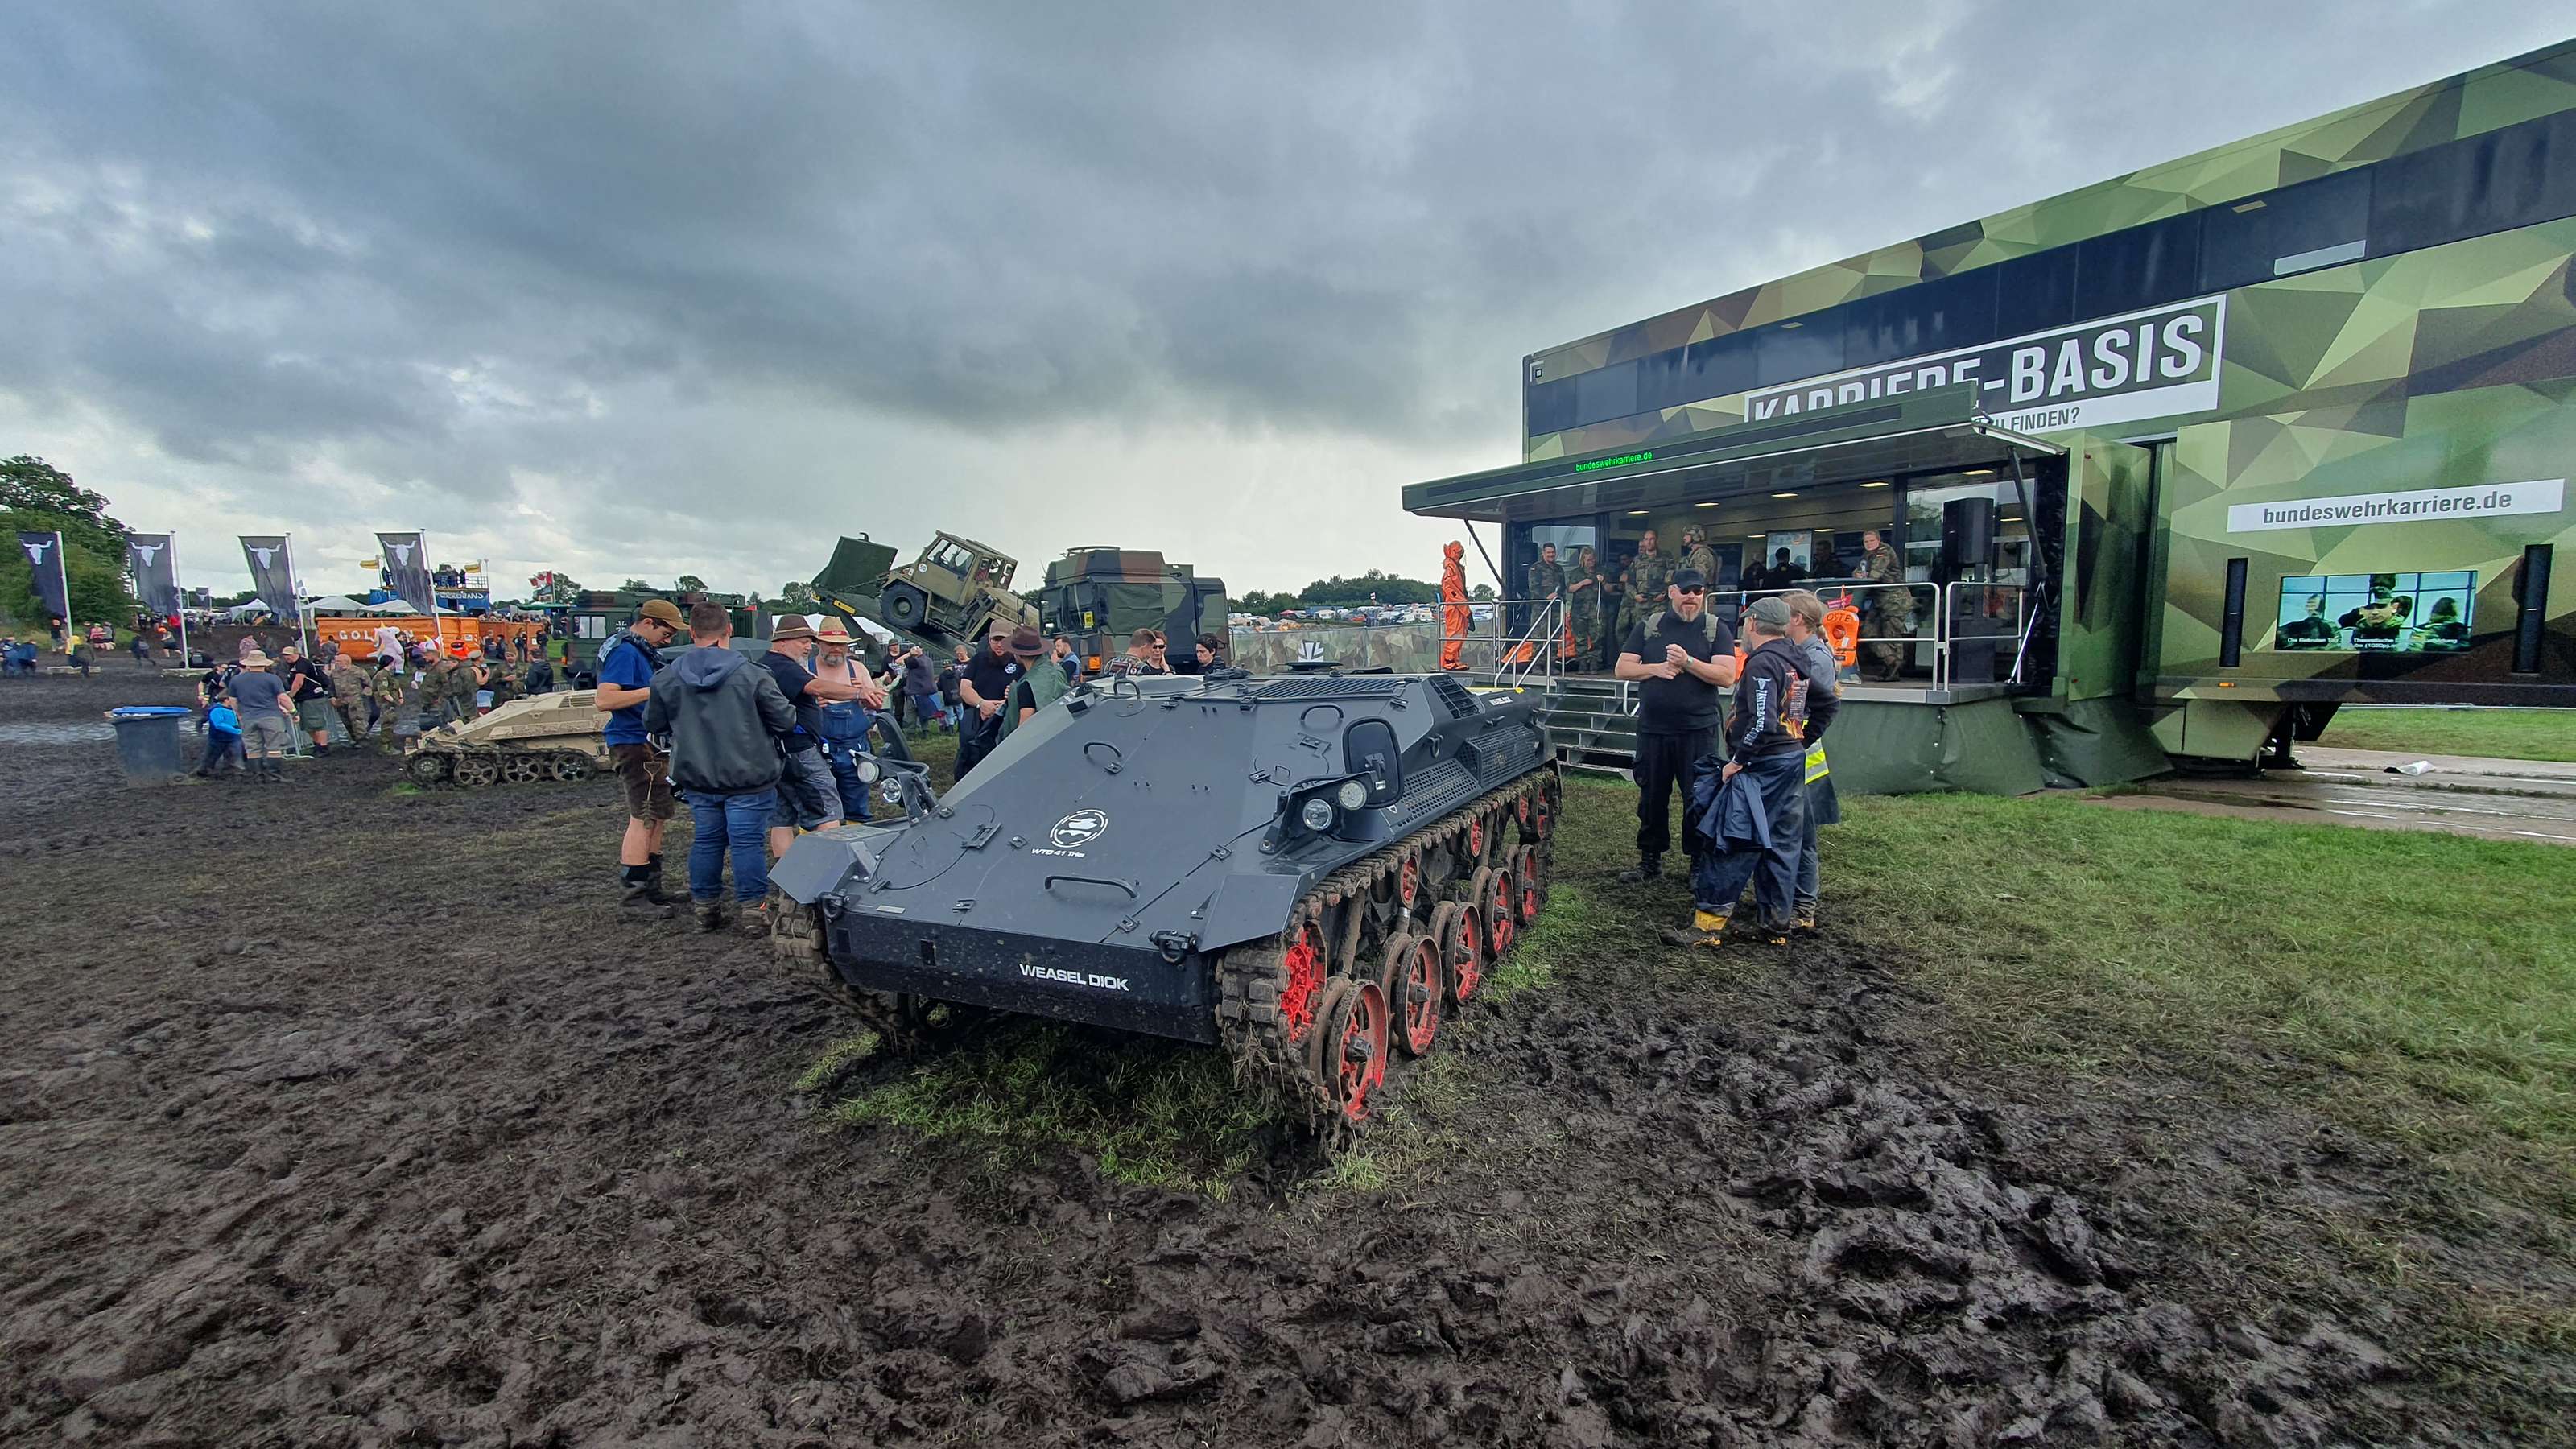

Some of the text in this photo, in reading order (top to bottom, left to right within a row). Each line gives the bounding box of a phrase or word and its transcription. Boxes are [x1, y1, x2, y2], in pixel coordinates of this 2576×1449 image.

[2012, 407, 2081, 431] FINDEN?
[1575, 452, 1653, 472] bundeswehrkarriere.de
[2263, 490, 2512, 524] bundeswehrkarriere.de
[1827, 613, 1852, 622] OSTE
[339, 630, 414, 642] GOLN
[1019, 964, 1087, 985] WEASEL
